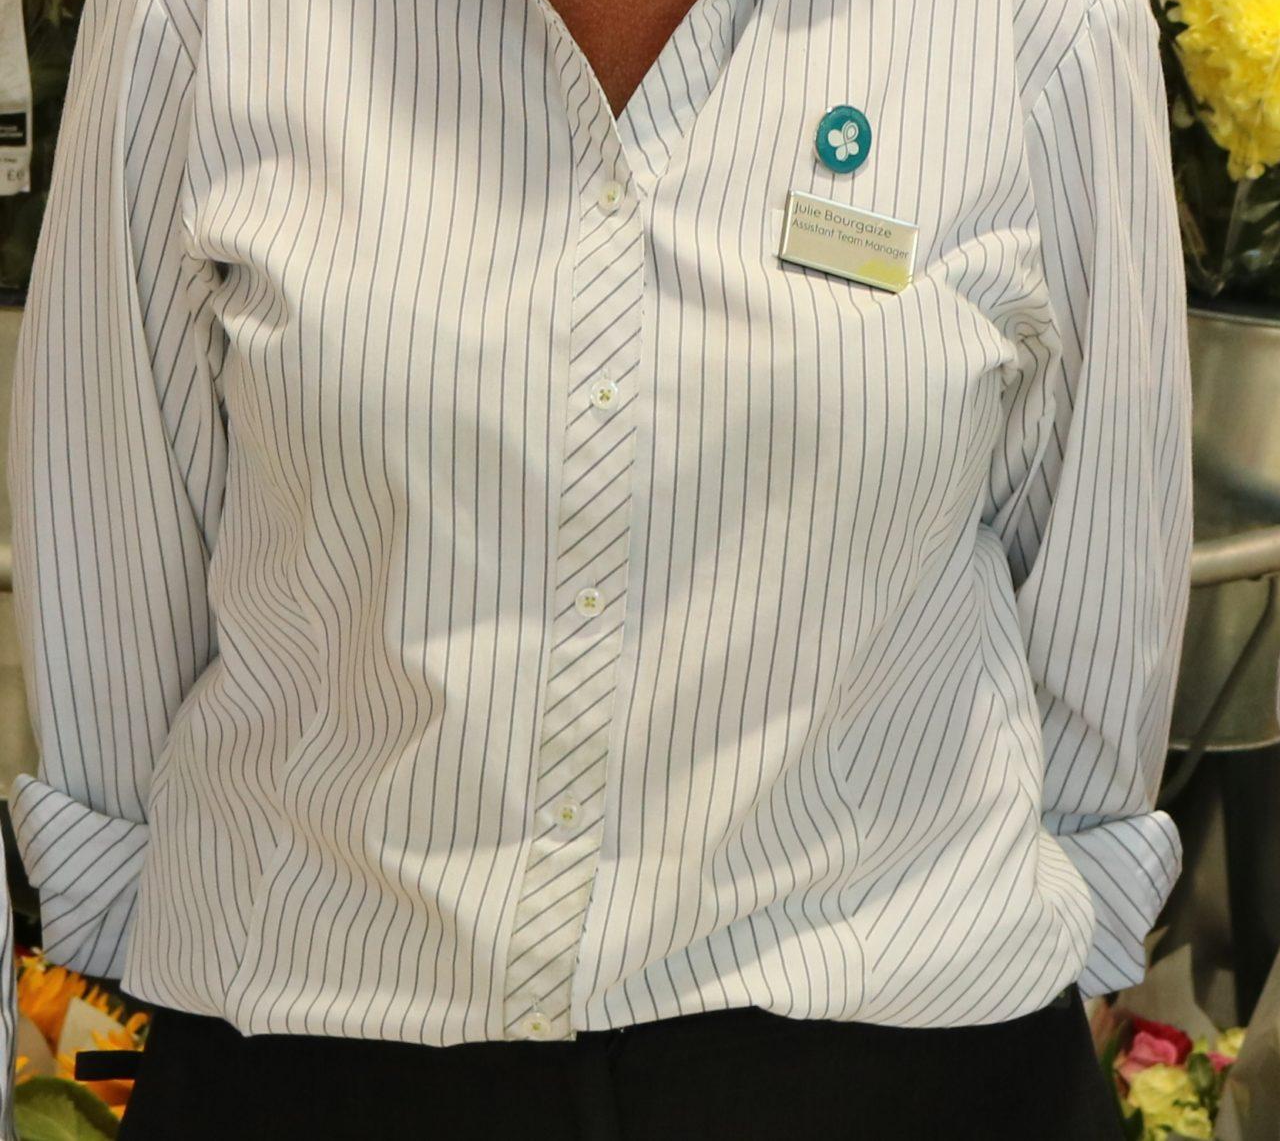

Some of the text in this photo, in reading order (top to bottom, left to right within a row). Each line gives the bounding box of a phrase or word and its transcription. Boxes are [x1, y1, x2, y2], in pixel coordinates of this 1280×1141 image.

[792, 218, 909, 258] Assistant Team Manager
[794, 201, 892, 238] Julie Bourgaize
